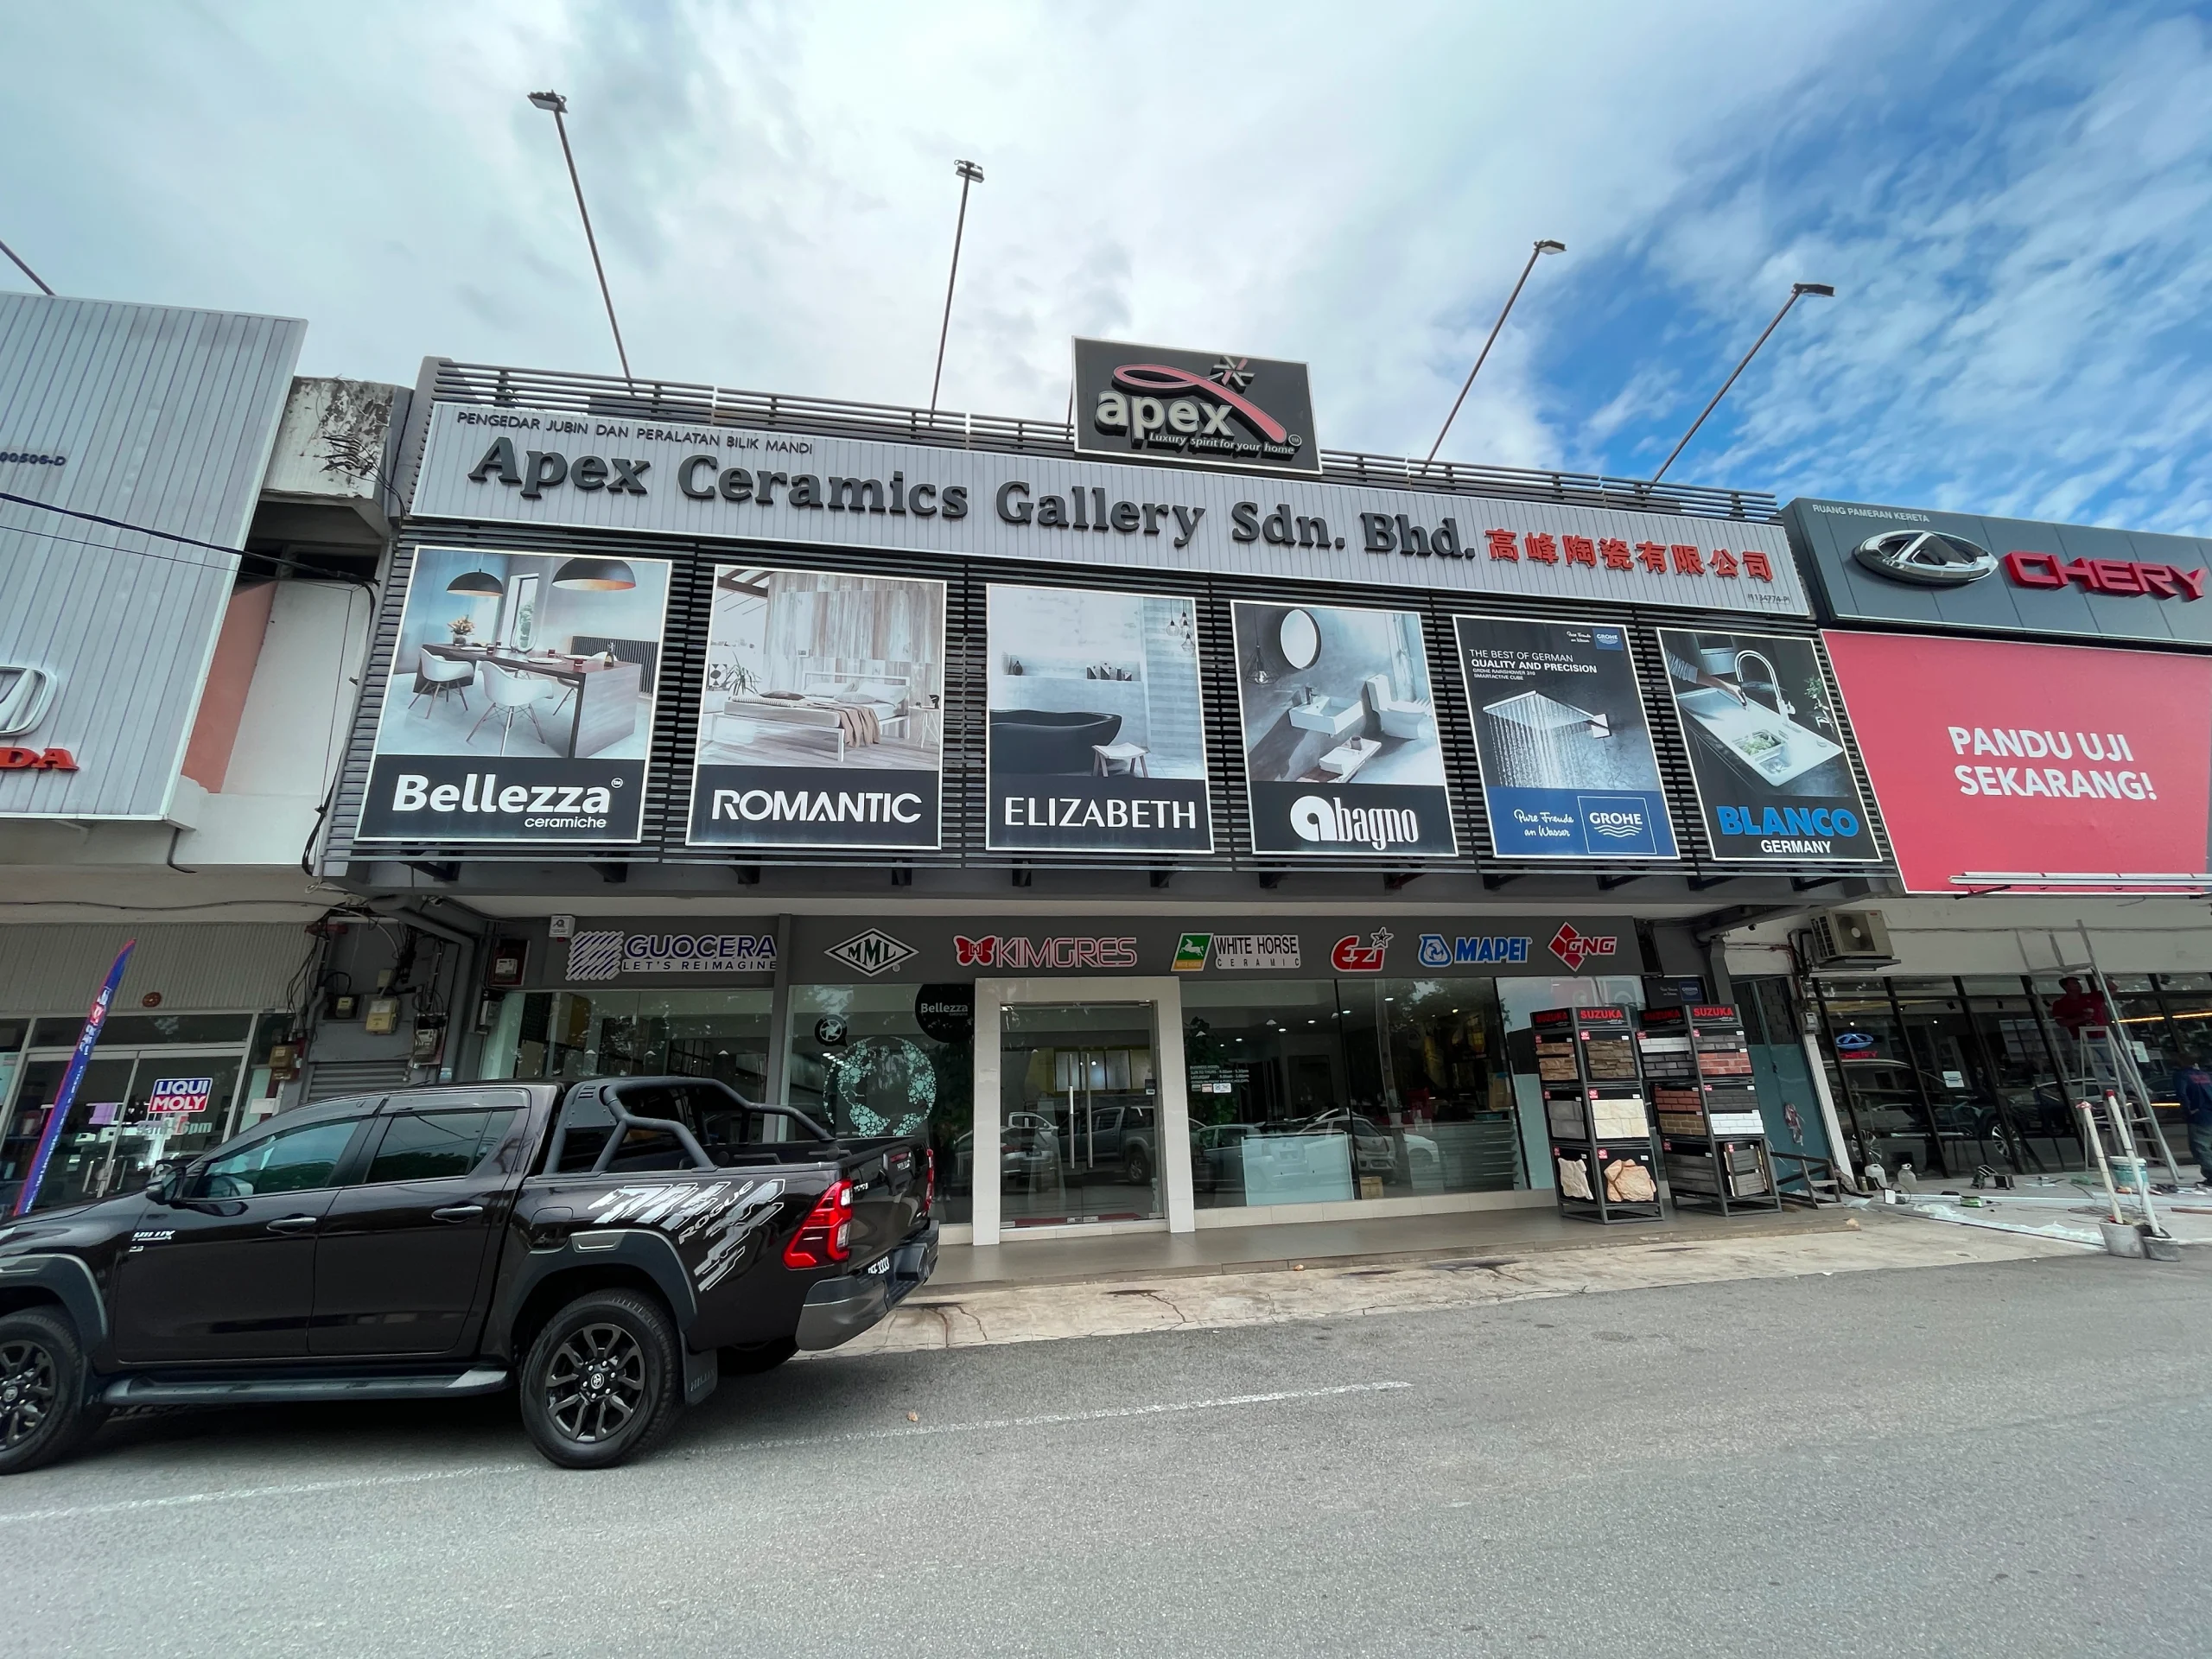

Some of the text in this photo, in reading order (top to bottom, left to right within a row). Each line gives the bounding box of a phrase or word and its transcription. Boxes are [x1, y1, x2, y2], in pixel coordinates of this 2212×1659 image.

[1095, 391, 1235, 448] apex
[457, 411, 812, 454] PENGEDAR JUBIN DAN PERALATAN BILIK MANDI
[1148, 433, 1187, 446] Luxury
[1190, 436, 1218, 448] spirit
[1219, 439, 1235, 448] for
[1236, 442, 1261, 451] your
[1264, 442, 1294, 454] home
[467, 436, 1475, 560] Apex Ceramics Gallery Sdn. Bhd.
[1812, 504, 1929, 523] RUANG PAMERAN KERETA
[1484, 528, 1774, 583] 高峰陶瓷有限公司
[2000, 550, 2206, 601] CHERY
[1471, 659, 1597, 673] QUALITY AND PRECISION
[1491, 651, 1514, 659] BEST
[1532, 652, 1573, 662] GERMAN
[1948, 727, 2134, 761] PANDU UJI
[1955, 766, 2157, 800] SEKARANG!
[392, 774, 610, 814] Bellezza
[712, 789, 923, 823] ROMANTIC
[1005, 797, 1196, 829] ELIZABETH
[1514, 809, 1574, 823] Pure Freude
[524, 816, 607, 829] ceramiche
[1589, 812, 1643, 824] GROHE
[1716, 806, 1859, 837] BLANCO
[1538, 825, 1570, 836] Wasser
[1761, 840, 1831, 853] GERMANY
[626, 936, 776, 957] GUOCERA
[848, 938, 896, 966] MML
[995, 937, 1138, 968] KIMGRES
[1216, 937, 1297, 954] WHITE HORSE
[1455, 938, 1529, 963] MAPEI
[1565, 938, 1617, 955] GNG
[623, 961, 777, 970] LET'S REIMAGINE
[1217, 958, 1300, 967] CERAMIC
[920, 1002, 969, 1013] Bellezza
[1580, 1009, 1624, 1019] SUZUKA
[1694, 1007, 1734, 1017] SUZUKA
[156, 1081, 208, 1095] LIQUI
[151, 1096, 207, 1111] MOLY
[678, 1180, 754, 1245] ROGUE
